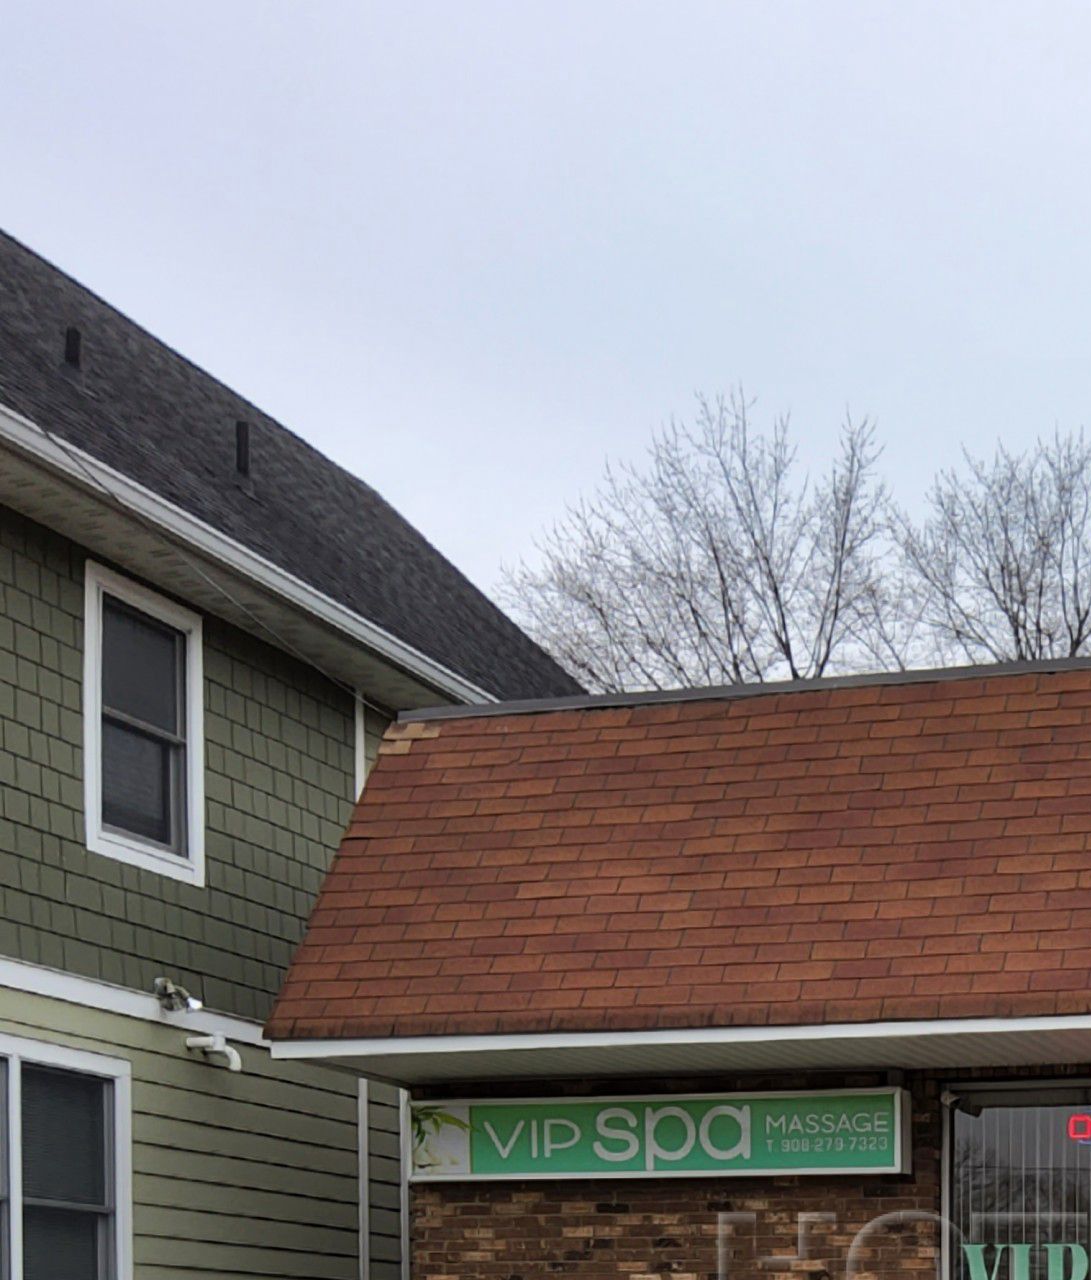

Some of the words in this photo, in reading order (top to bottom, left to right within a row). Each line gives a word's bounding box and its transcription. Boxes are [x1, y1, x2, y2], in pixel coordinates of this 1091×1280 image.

[483, 1118, 582, 1159] VIP
[593, 1104, 752, 1171] spa
[766, 1111, 890, 1135] MASSAGE
